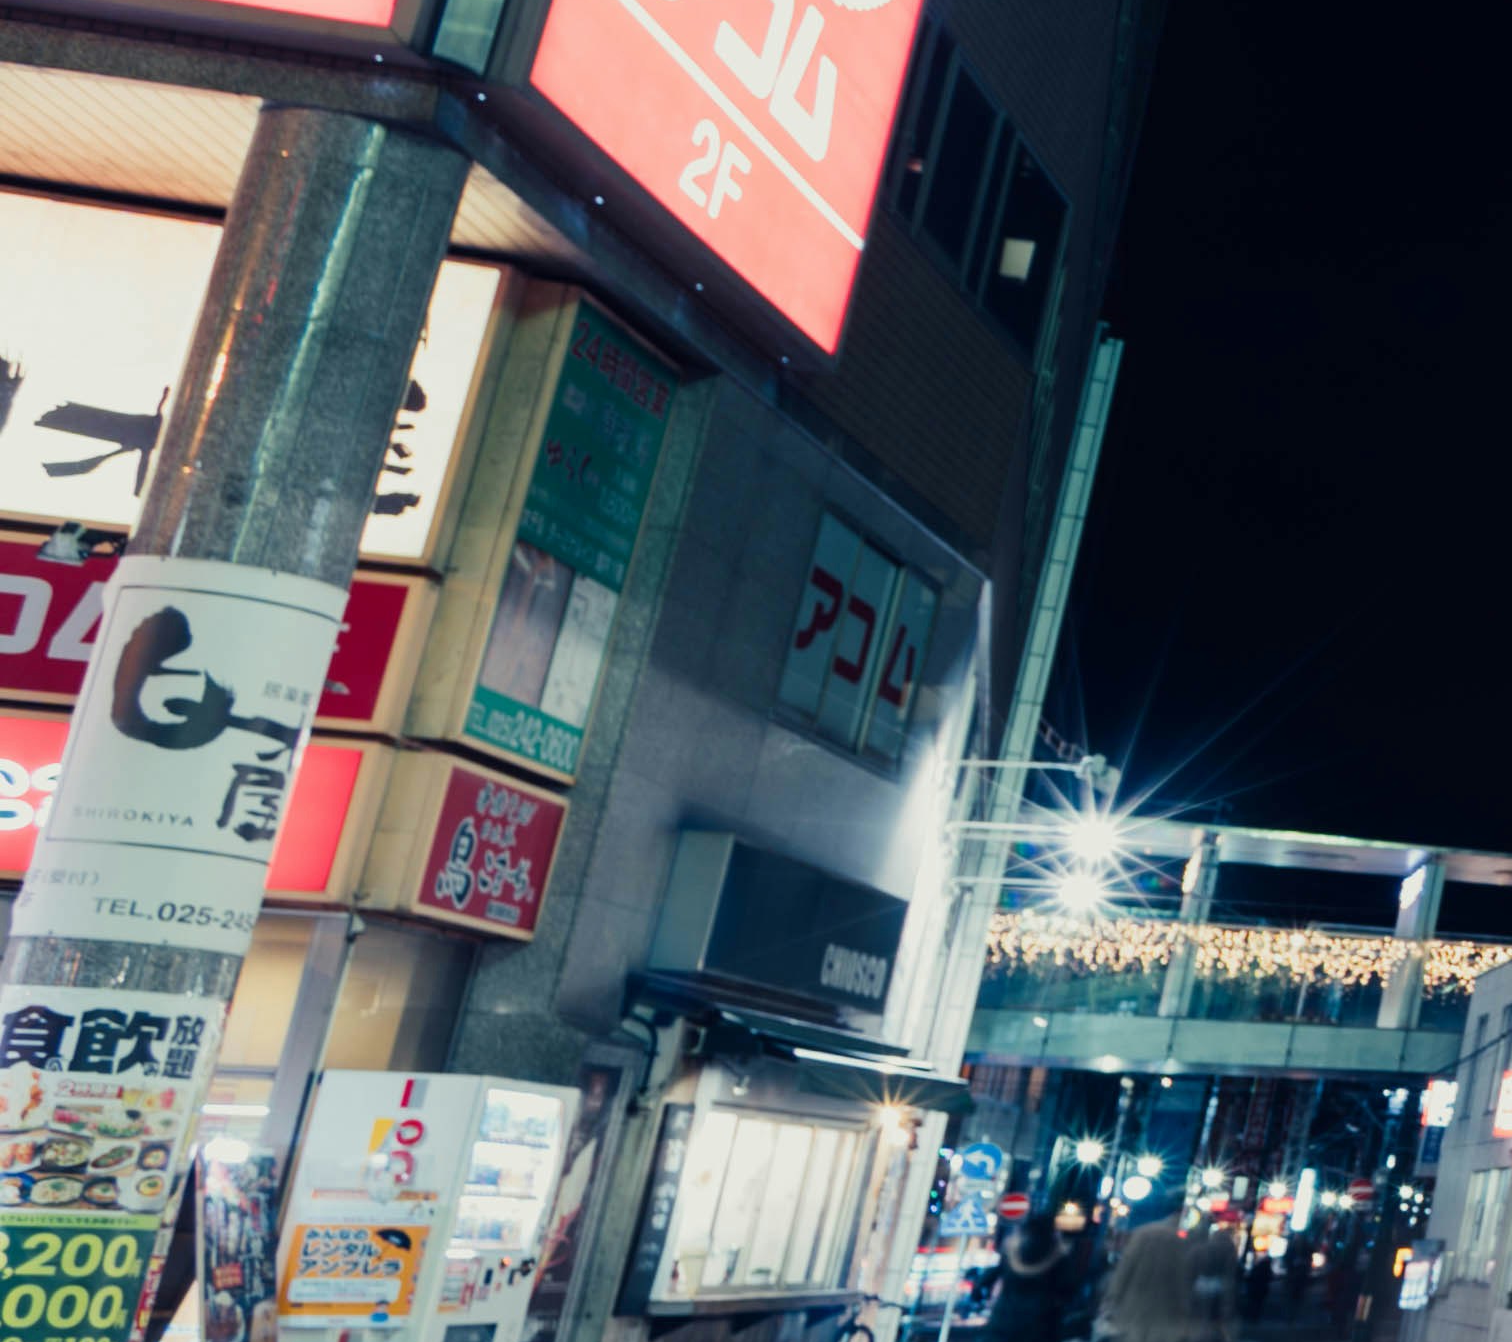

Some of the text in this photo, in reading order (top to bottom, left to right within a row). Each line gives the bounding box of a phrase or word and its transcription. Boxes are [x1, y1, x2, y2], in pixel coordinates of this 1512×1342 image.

[678, 118, 753, 220] 2F
[794, 565, 916, 708] アコム
[72, 805, 195, 829] SHIROKIYA
